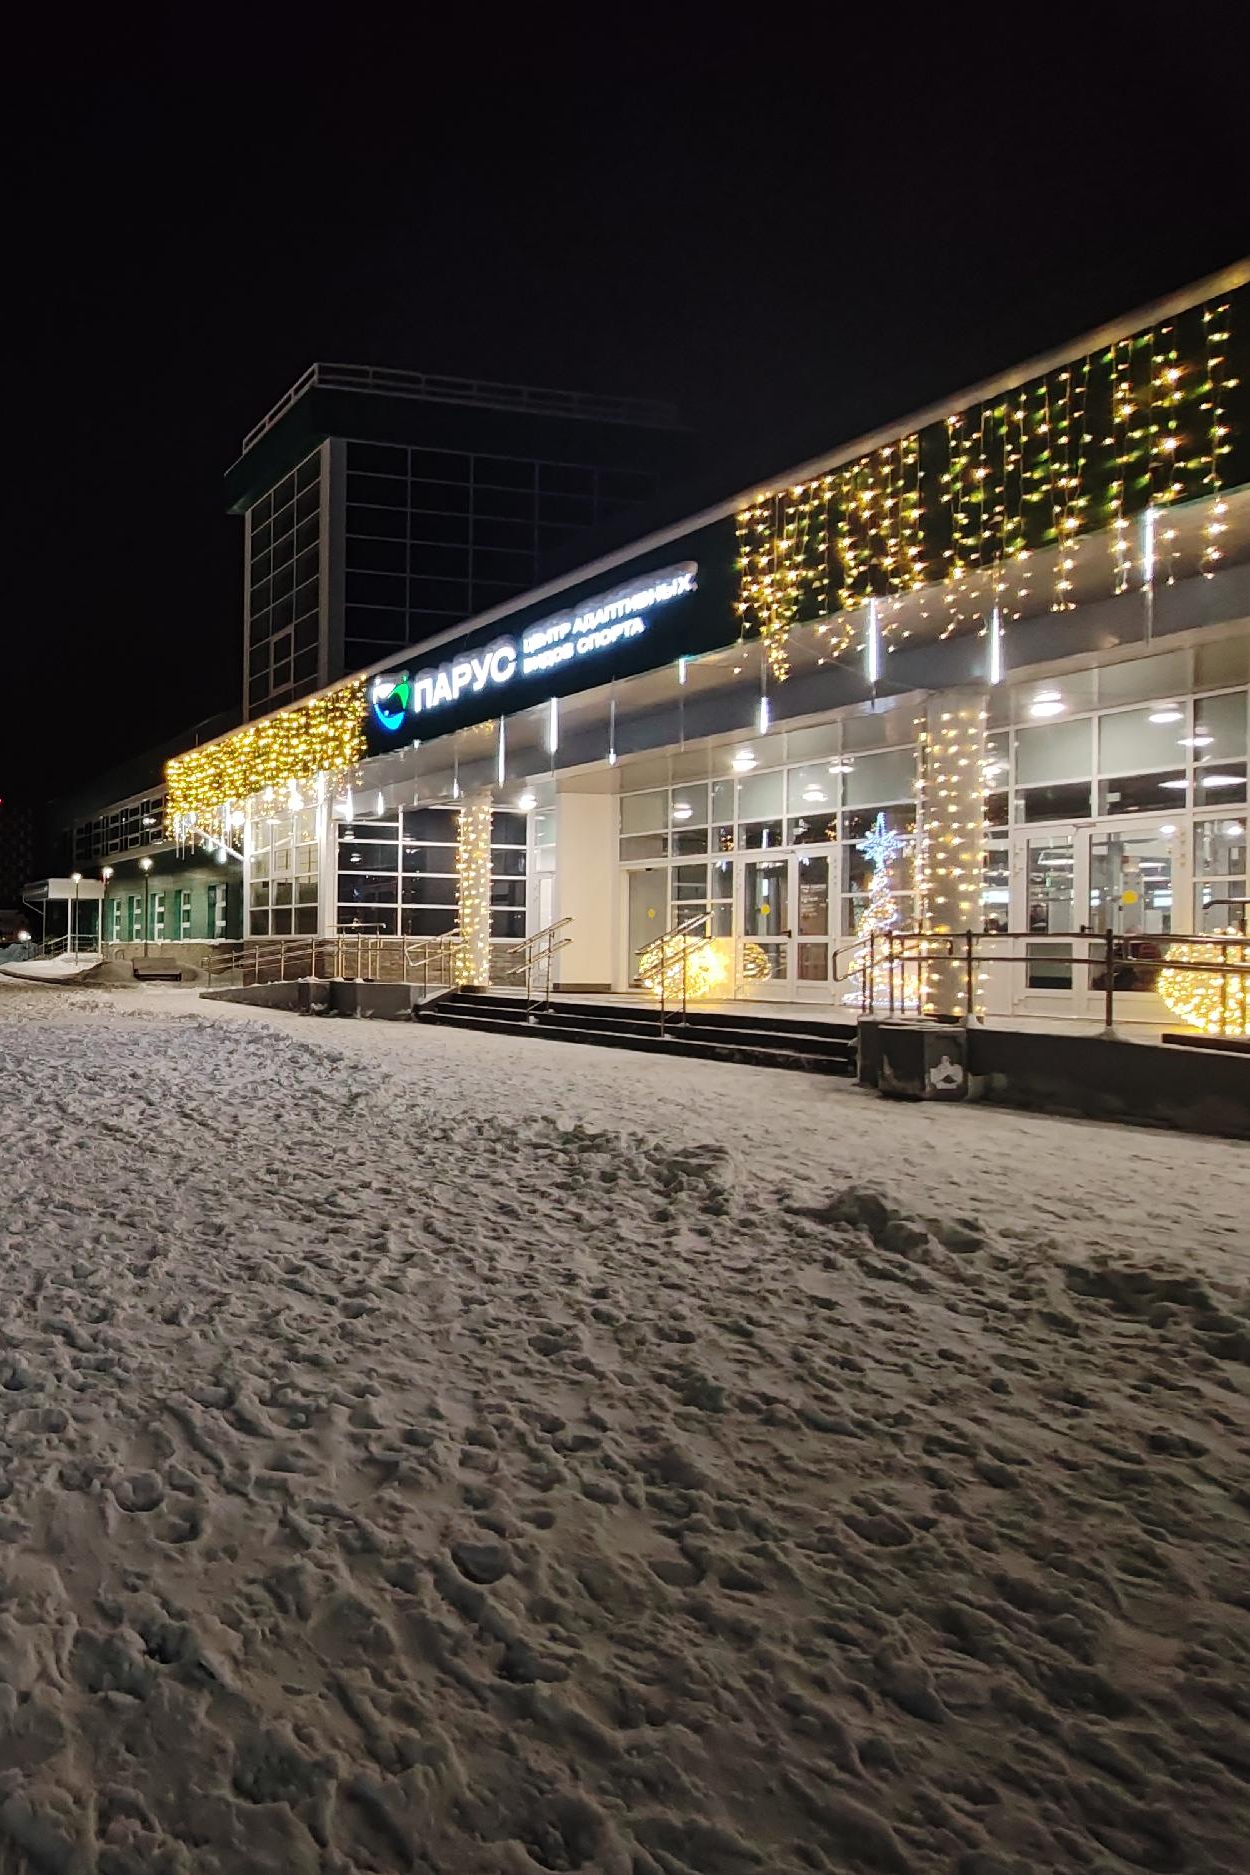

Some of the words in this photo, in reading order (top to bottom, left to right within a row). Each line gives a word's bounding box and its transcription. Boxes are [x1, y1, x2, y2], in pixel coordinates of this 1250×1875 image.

[523, 622, 572, 653] ЦЕНТР
[572, 573, 693, 635] АДАПТИВНЫХ
[523, 642, 574, 674] ВИДОВ
[576, 617, 645, 654] СПОРТА
[414, 645, 517, 713] ПАРУС
